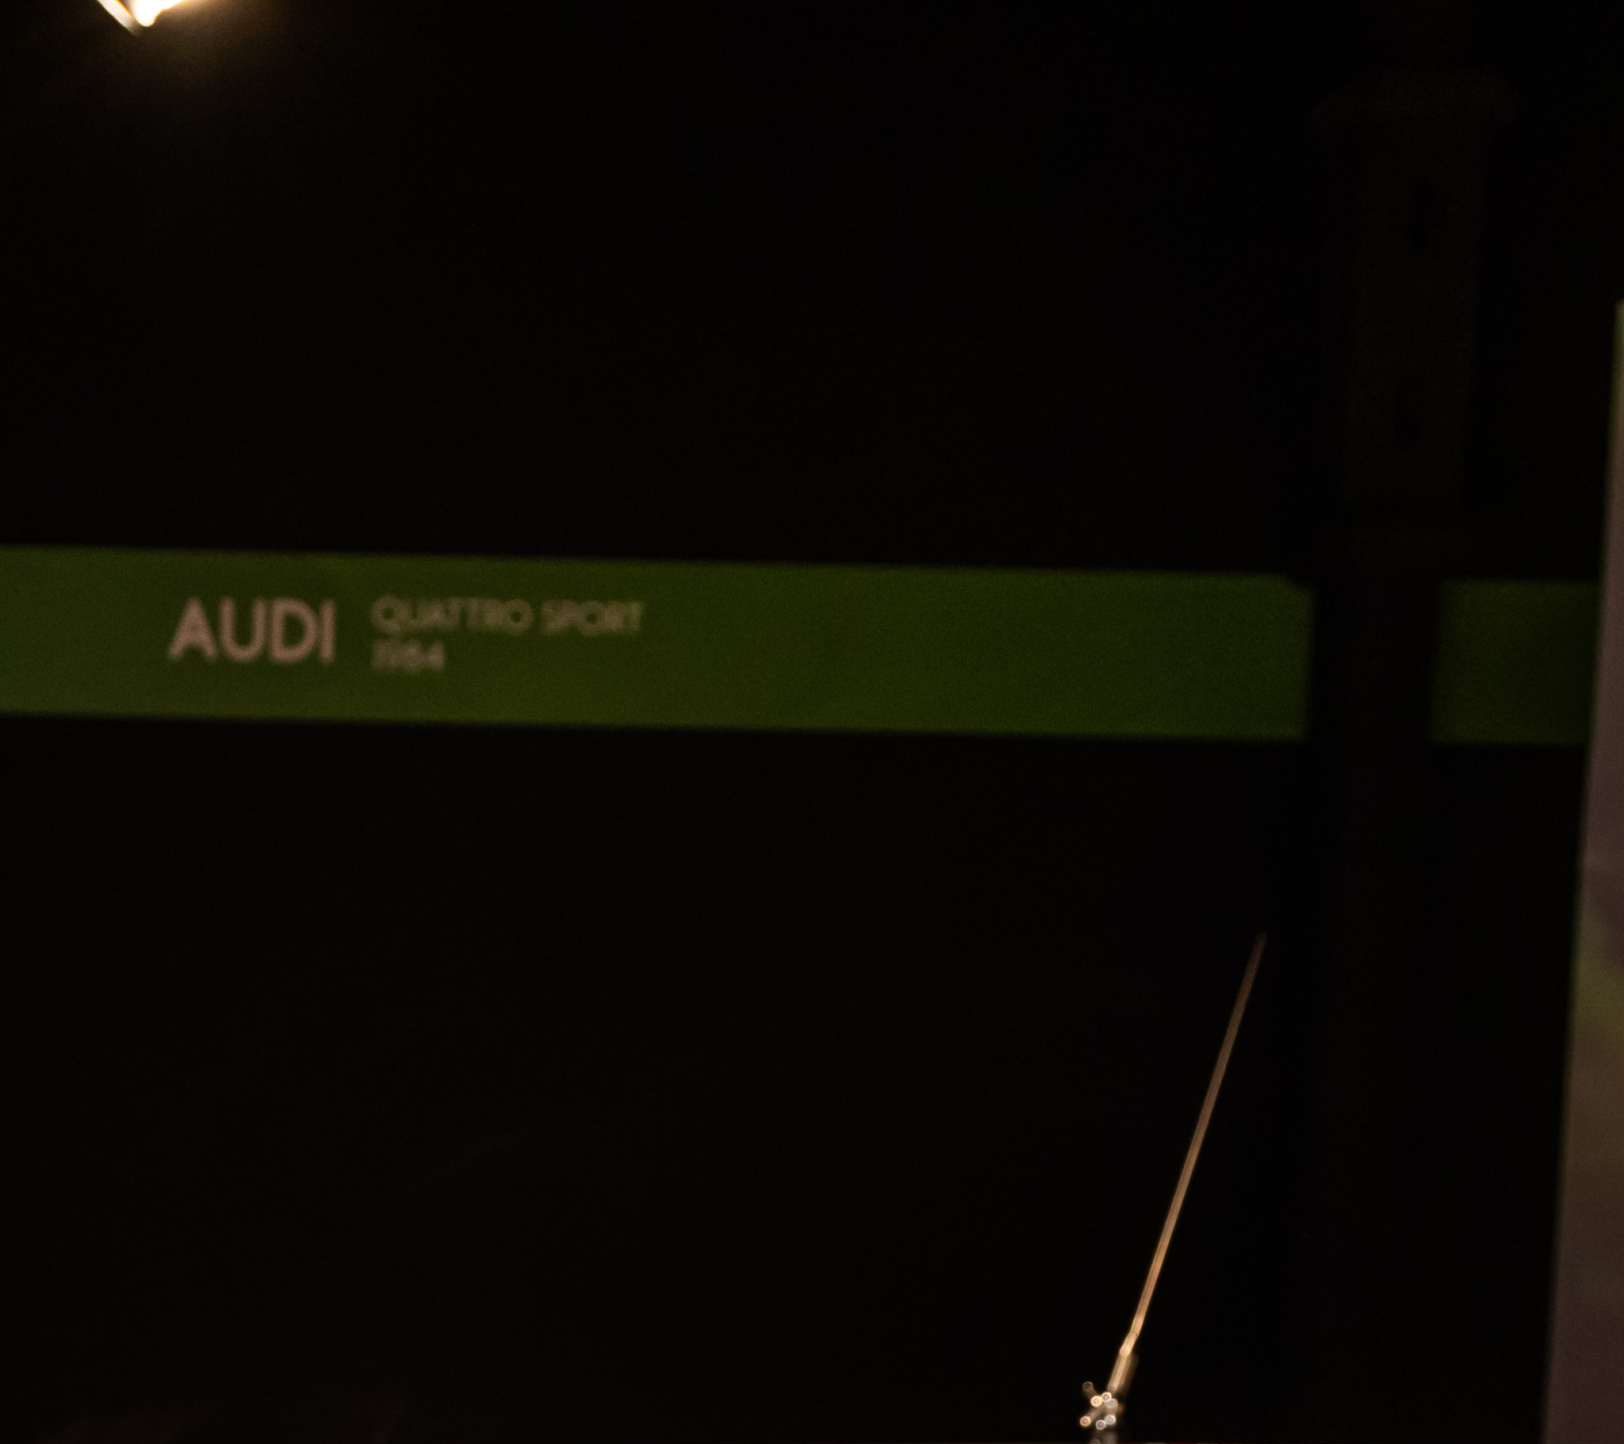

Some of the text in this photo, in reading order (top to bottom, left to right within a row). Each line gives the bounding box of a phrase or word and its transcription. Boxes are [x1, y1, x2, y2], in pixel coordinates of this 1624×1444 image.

[167, 596, 338, 664] AUDI
[370, 595, 643, 637] QUATTRO SPORT
